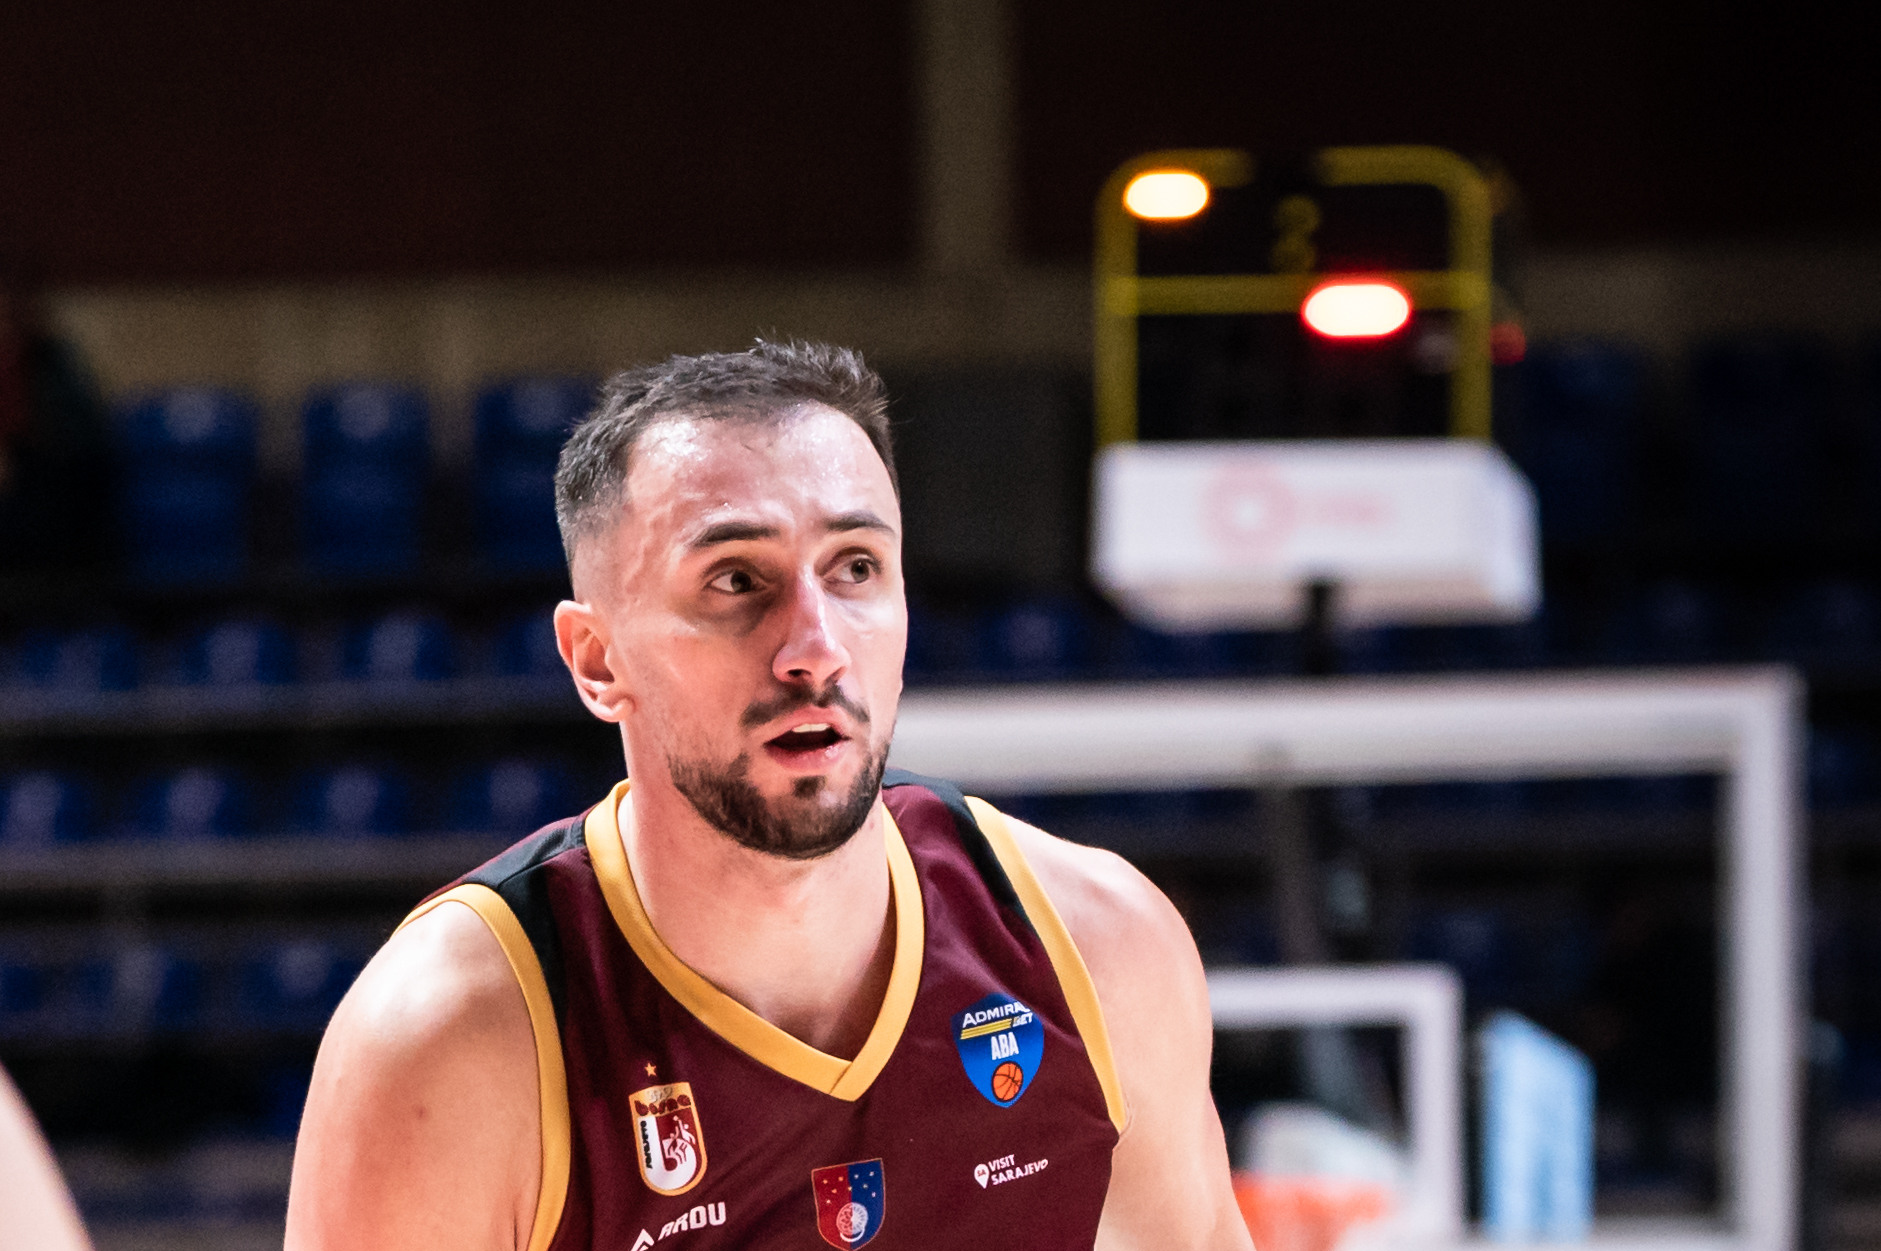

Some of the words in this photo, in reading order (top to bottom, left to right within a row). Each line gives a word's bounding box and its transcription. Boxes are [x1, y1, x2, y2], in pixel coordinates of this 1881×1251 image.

[990, 1031, 1020, 1061] ABA
[988, 1154, 1015, 1172] VISIT
[991, 1158, 1049, 1186] SARAJEVO
